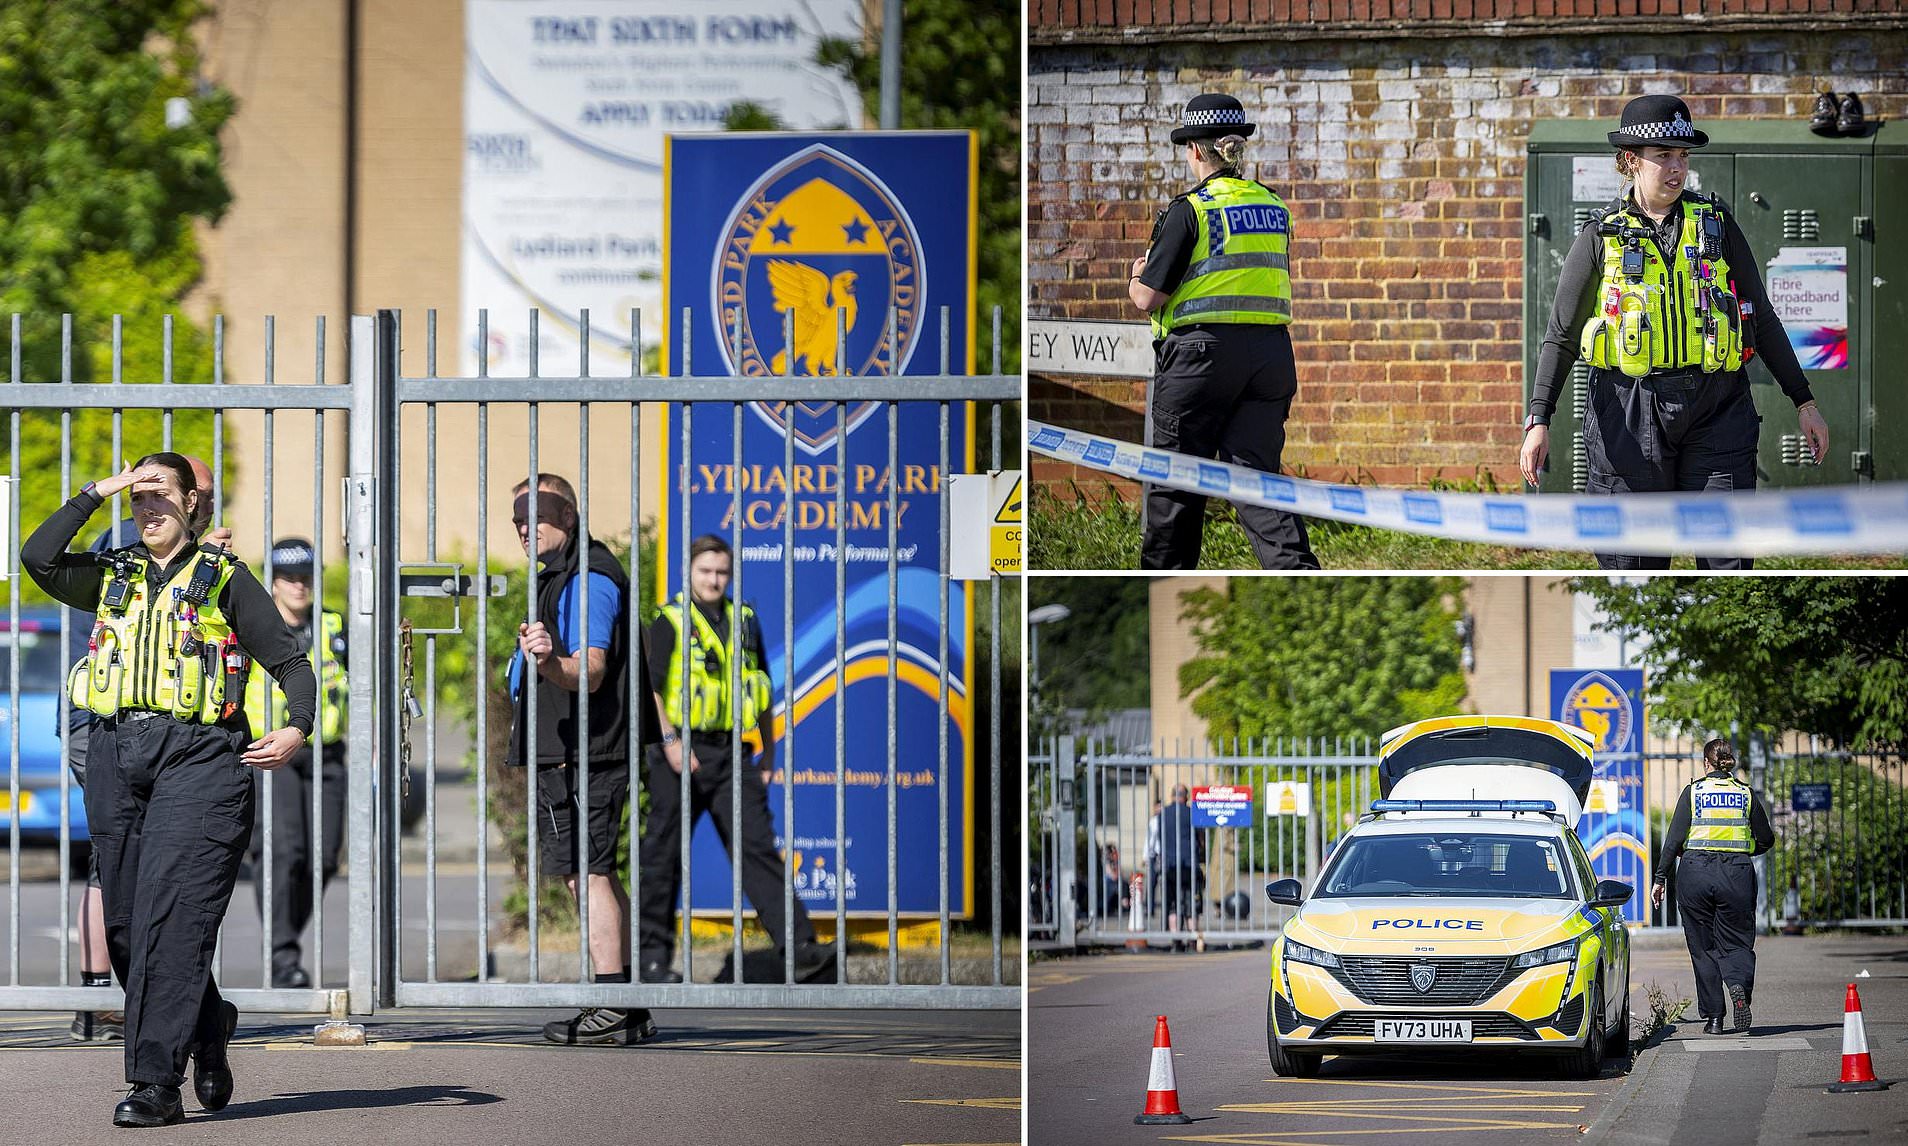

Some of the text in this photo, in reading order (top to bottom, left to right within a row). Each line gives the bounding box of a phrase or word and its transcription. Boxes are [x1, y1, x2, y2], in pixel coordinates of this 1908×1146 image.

[611, 15, 696, 42] SIXTH
[1229, 208, 1285, 230] POLICE
[1772, 277, 1802, 290] Fibre
[1772, 290, 1840, 303] broadband
[1785, 303, 1813, 315] here
[1030, 333, 1121, 362] EY WAY
[791, 546, 817, 562] nto
[1702, 794, 1742, 807] POLICE
[812, 867, 857, 889] Pak
[1371, 919, 1484, 931] POLICE
[1382, 1022, 1464, 1038] FV73 UHA
